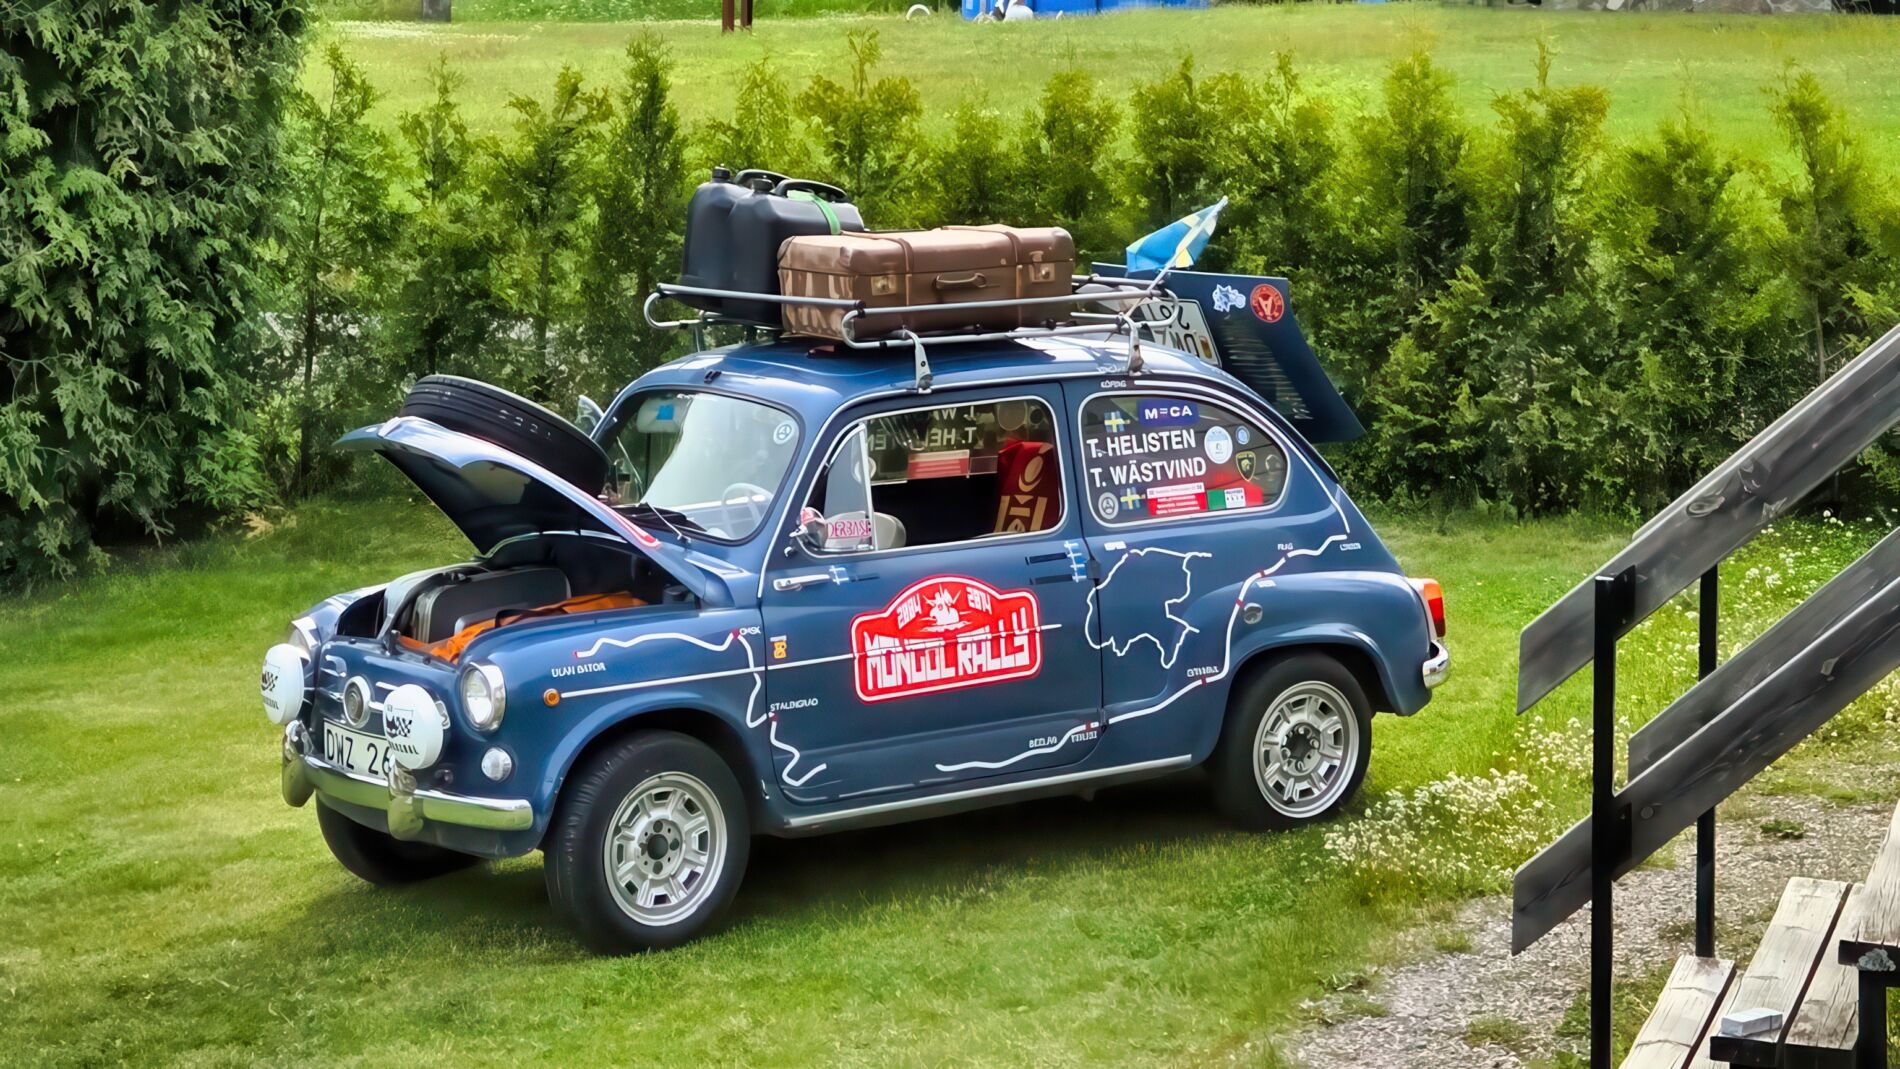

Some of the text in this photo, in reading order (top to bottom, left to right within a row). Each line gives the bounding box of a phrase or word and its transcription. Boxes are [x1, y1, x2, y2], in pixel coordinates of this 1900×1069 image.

[1086, 428, 1197, 459] T. HELISTEN
[1090, 456, 1207, 488] T. WÄSTVIND
[863, 606, 1031, 691] MONGOL RALLY
